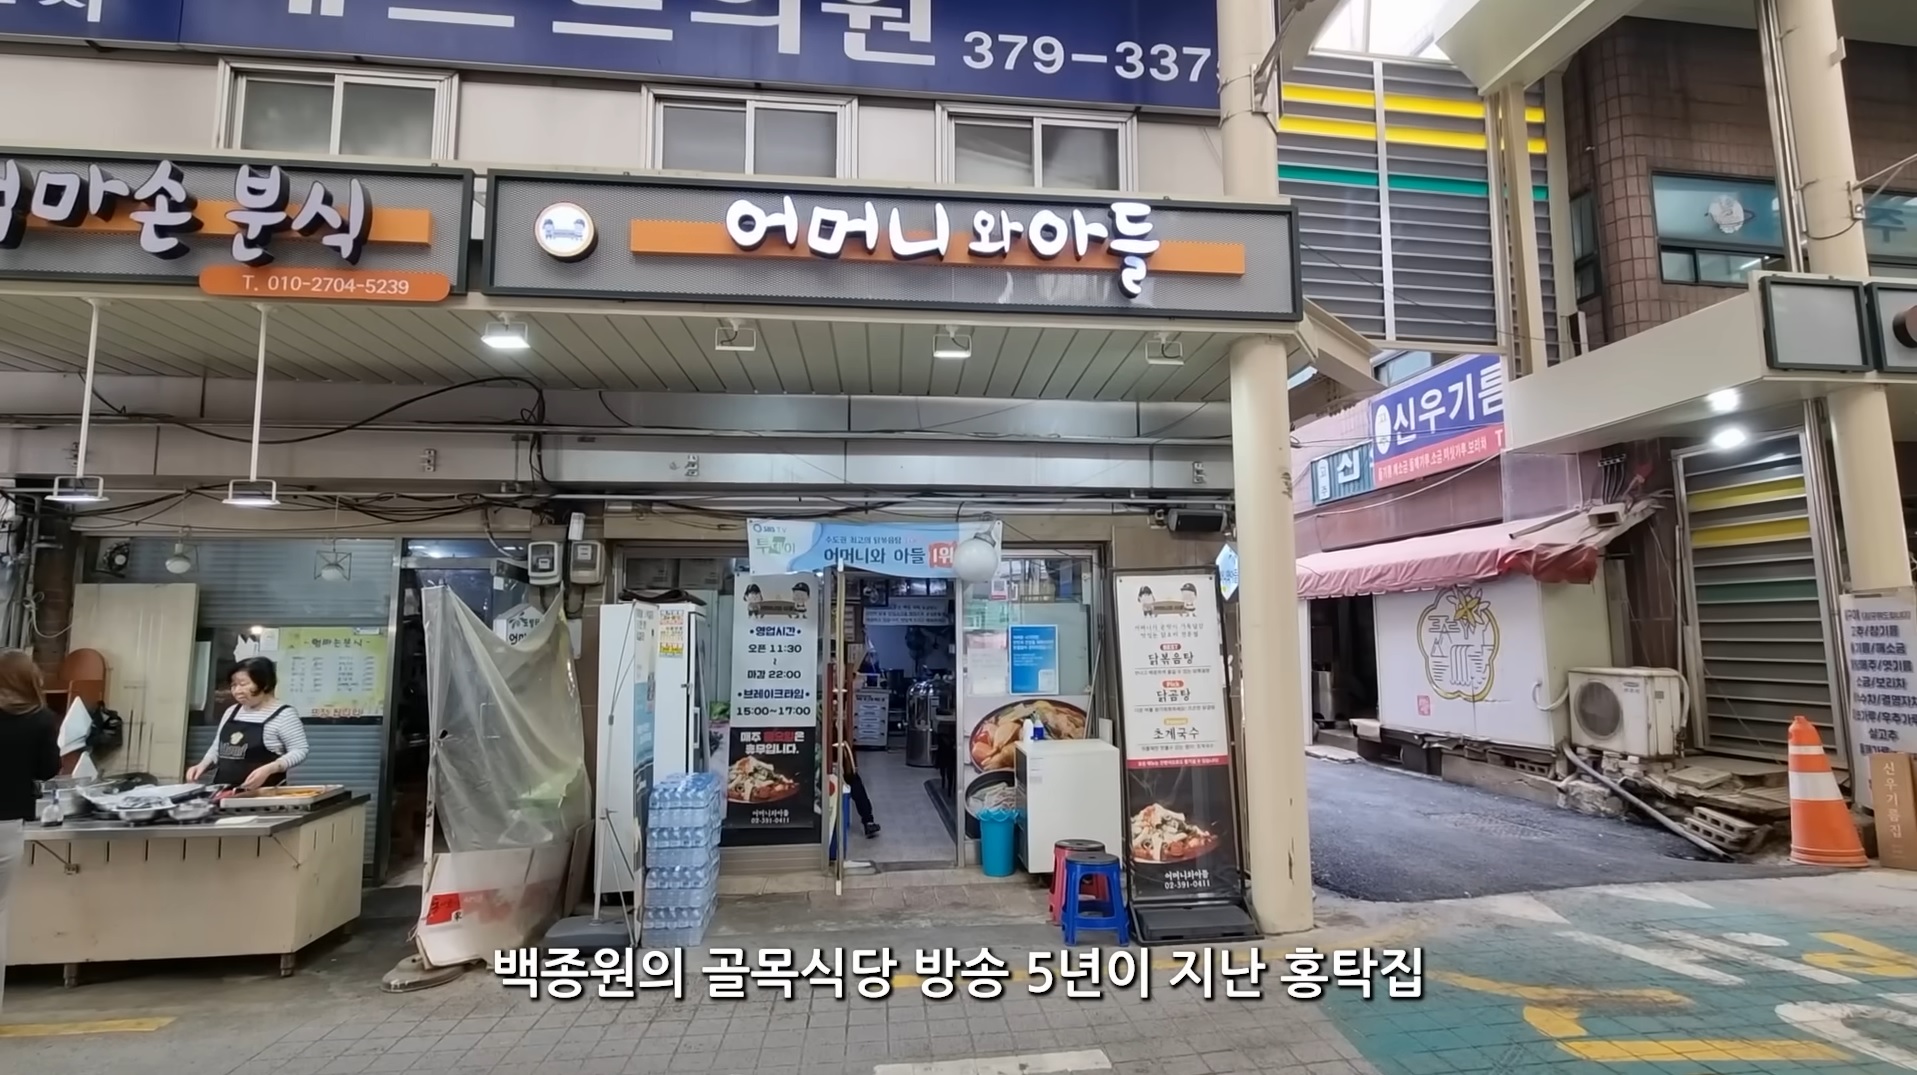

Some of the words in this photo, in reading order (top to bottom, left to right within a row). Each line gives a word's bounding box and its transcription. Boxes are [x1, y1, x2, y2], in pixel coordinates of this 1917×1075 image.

[962, 31, 1219, 82] 379-337
[224, 164, 366, 262] 분식
[242, 275, 259, 291] T.
[267, 276, 410, 296] 010-2704-5239
[1393, 362, 1503, 446] 신우기름
[823, 547, 886, 564] 어머니와
[894, 547, 926, 565] 아들
[755, 626, 796, 637] 영업시간
[748, 644, 767, 653] 오픈
[769, 644, 802, 653] 11:30
[1148, 651, 1194, 665] 닭볶음탕
[747, 670, 766, 679] 마감
[768, 670, 801, 679] 22:00
[743, 688, 804, 699] 브레이크타임
[1156, 687, 1191, 703] 닭곰탕
[736, 706, 811, 716] 15:00~17:00
[740, 731, 762, 742] 매주
[1164, 879, 1211, 889] 02-391-0411
